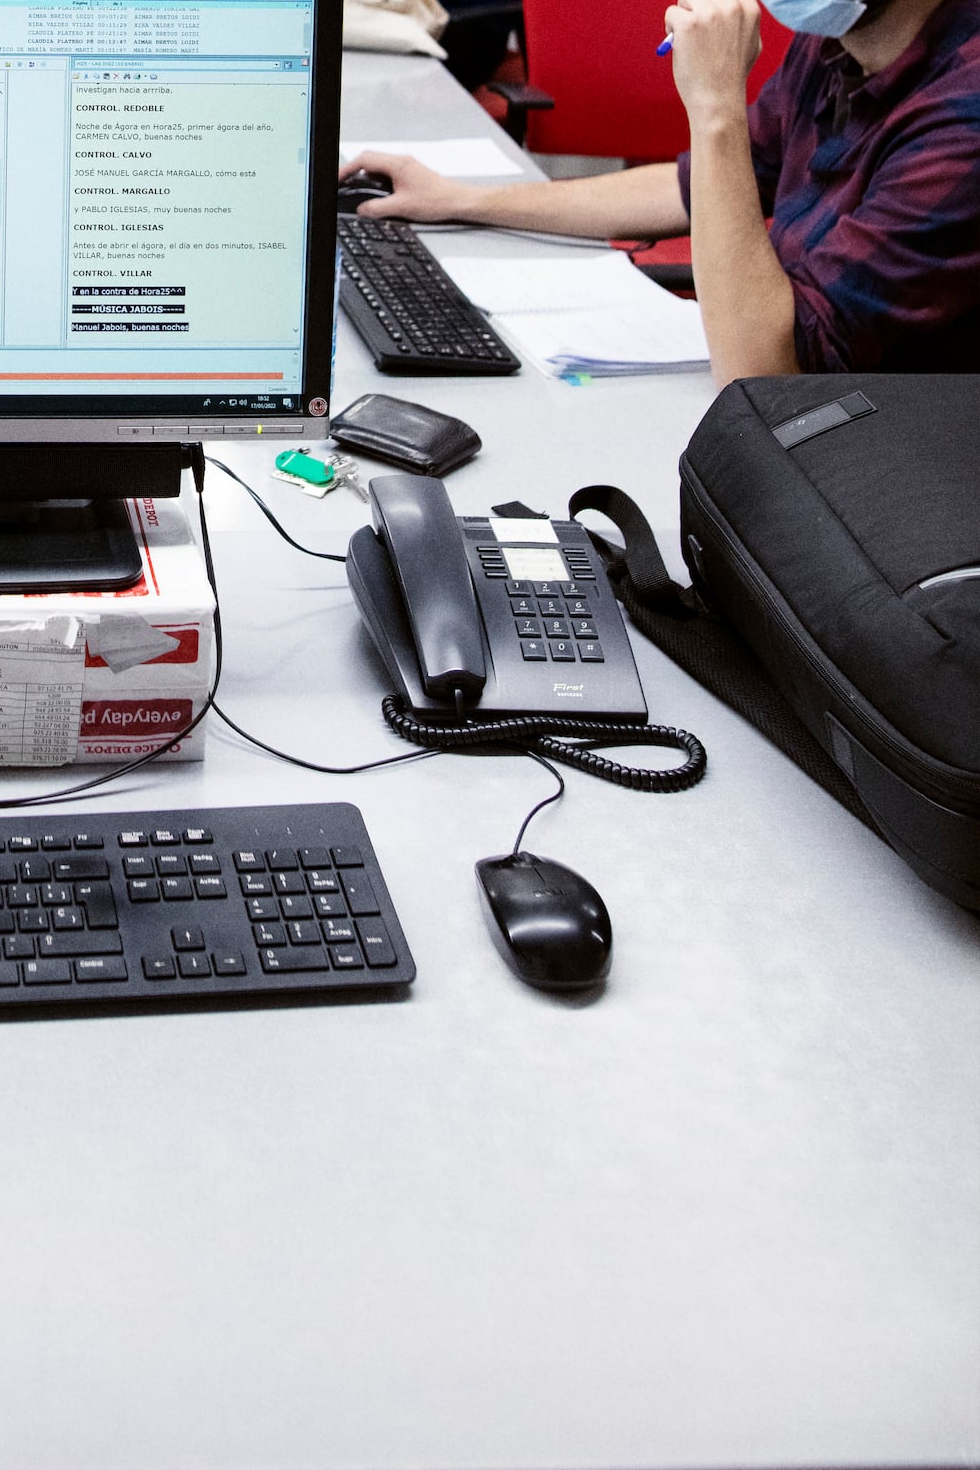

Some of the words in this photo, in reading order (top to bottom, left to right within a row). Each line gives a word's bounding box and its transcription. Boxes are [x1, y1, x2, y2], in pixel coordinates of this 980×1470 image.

[76, 85, 117, 95] investigan
[119, 85, 140, 93] hacia
[114, 121, 138, 132] Ágora
[152, 123, 184, 131] Hora25,
[187, 123, 214, 132] primer
[216, 123, 239, 133] ágora
[241, 123, 254, 131] del
[256, 124, 273, 132] año,
[75, 131, 109, 140] CARMEN
[111, 131, 141, 141] CALVO,
[144, 131, 172, 140] buenas
[174, 131, 202, 140] noches
[74, 167, 94, 176] JOSÉ
[131, 168, 164, 176] GARCÍA
[166, 170, 212, 178] MARGALLO,
[81, 205, 107, 213] PABLO
[110, 205, 150, 214] IGLESIAS,
[153, 207, 171, 215] muy
[173, 205, 201, 213] buenas
[203, 205, 231, 213] noches
[72, 241, 95, 249] Antes
[97, 241, 107, 249] de
[109, 241, 129, 249] abrir
[131, 241, 138, 249] el
[140, 241, 166, 251] ágora,
[169, 241, 176, 249] el
[178, 241, 190, 249] día
[205, 241, 219, 249] dos
[221, 241, 255, 250] minutos,
[258, 241, 287, 249] ISABEL
[72, 251, 104, 260] VILLAR,
[553, 683, 584, 692] First
[101, 708, 181, 726] everyday
